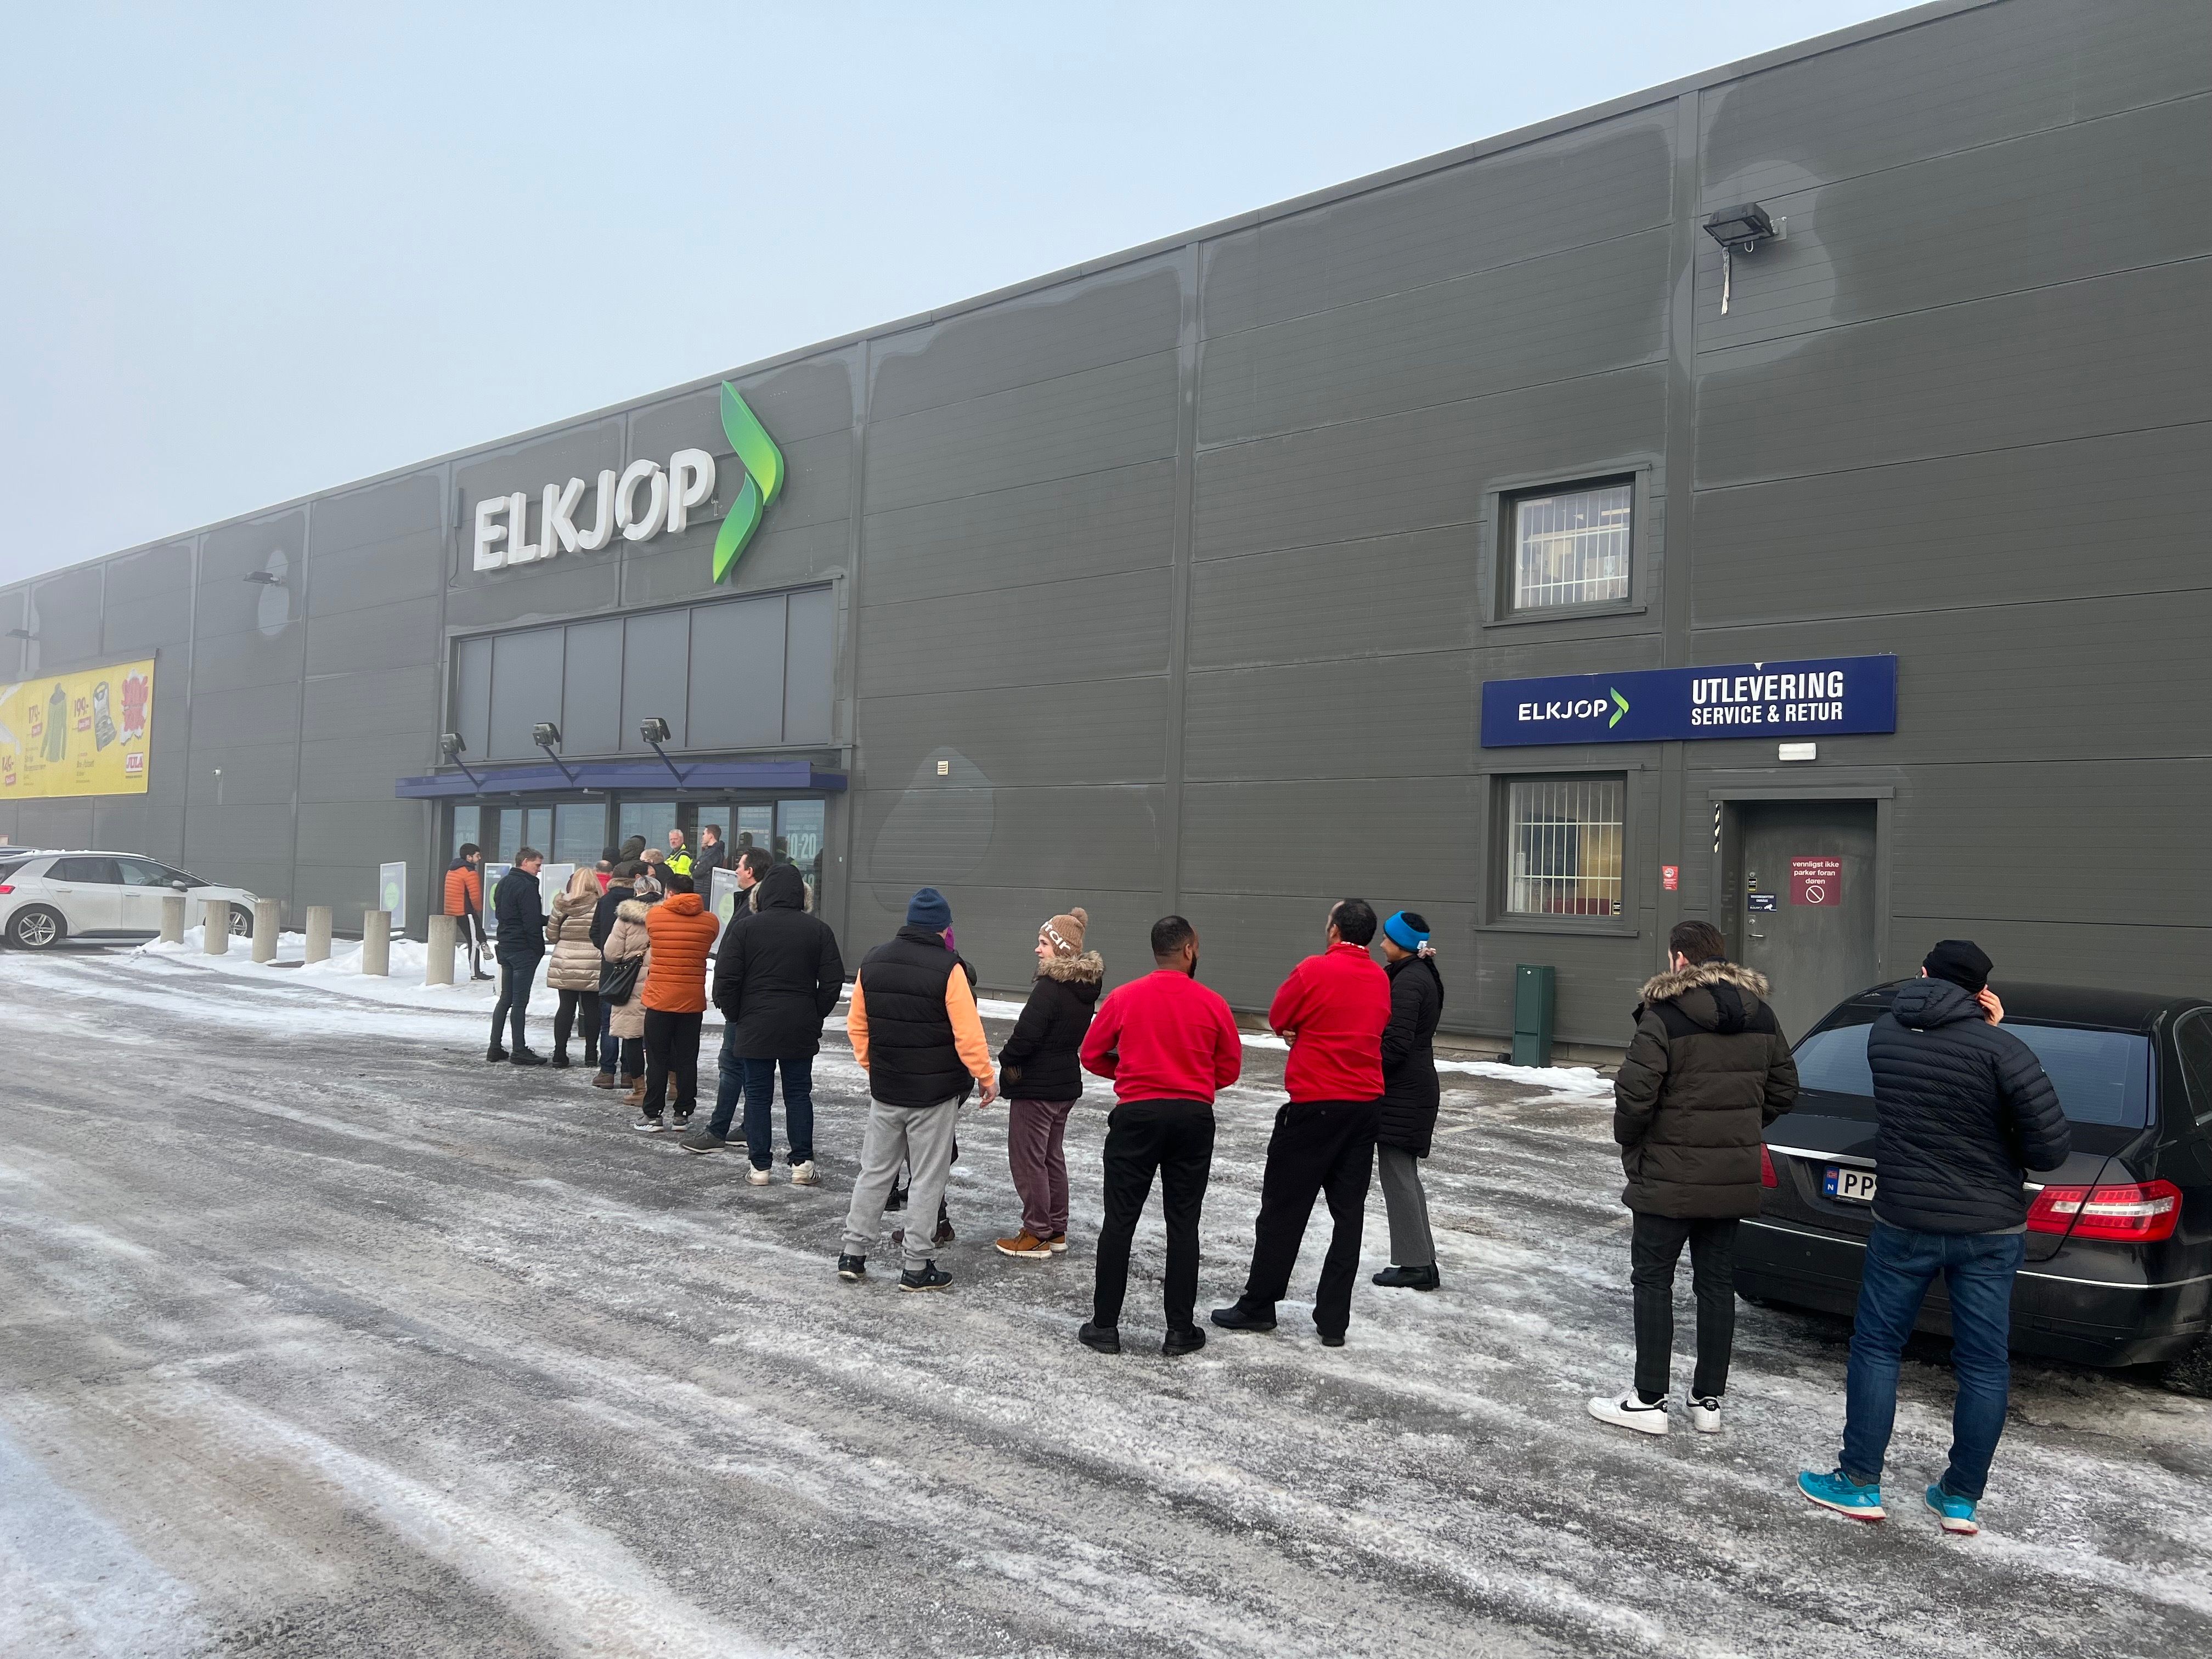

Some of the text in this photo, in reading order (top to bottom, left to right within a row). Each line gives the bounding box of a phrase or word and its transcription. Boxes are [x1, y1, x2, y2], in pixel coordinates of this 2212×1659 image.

[1692, 671, 1843, 704] UTLEVERING
[1691, 702, 1842, 725] SERVICE & RETUR
[126, 757, 143, 769] JULA
[786, 833, 817, 860] 10-20
